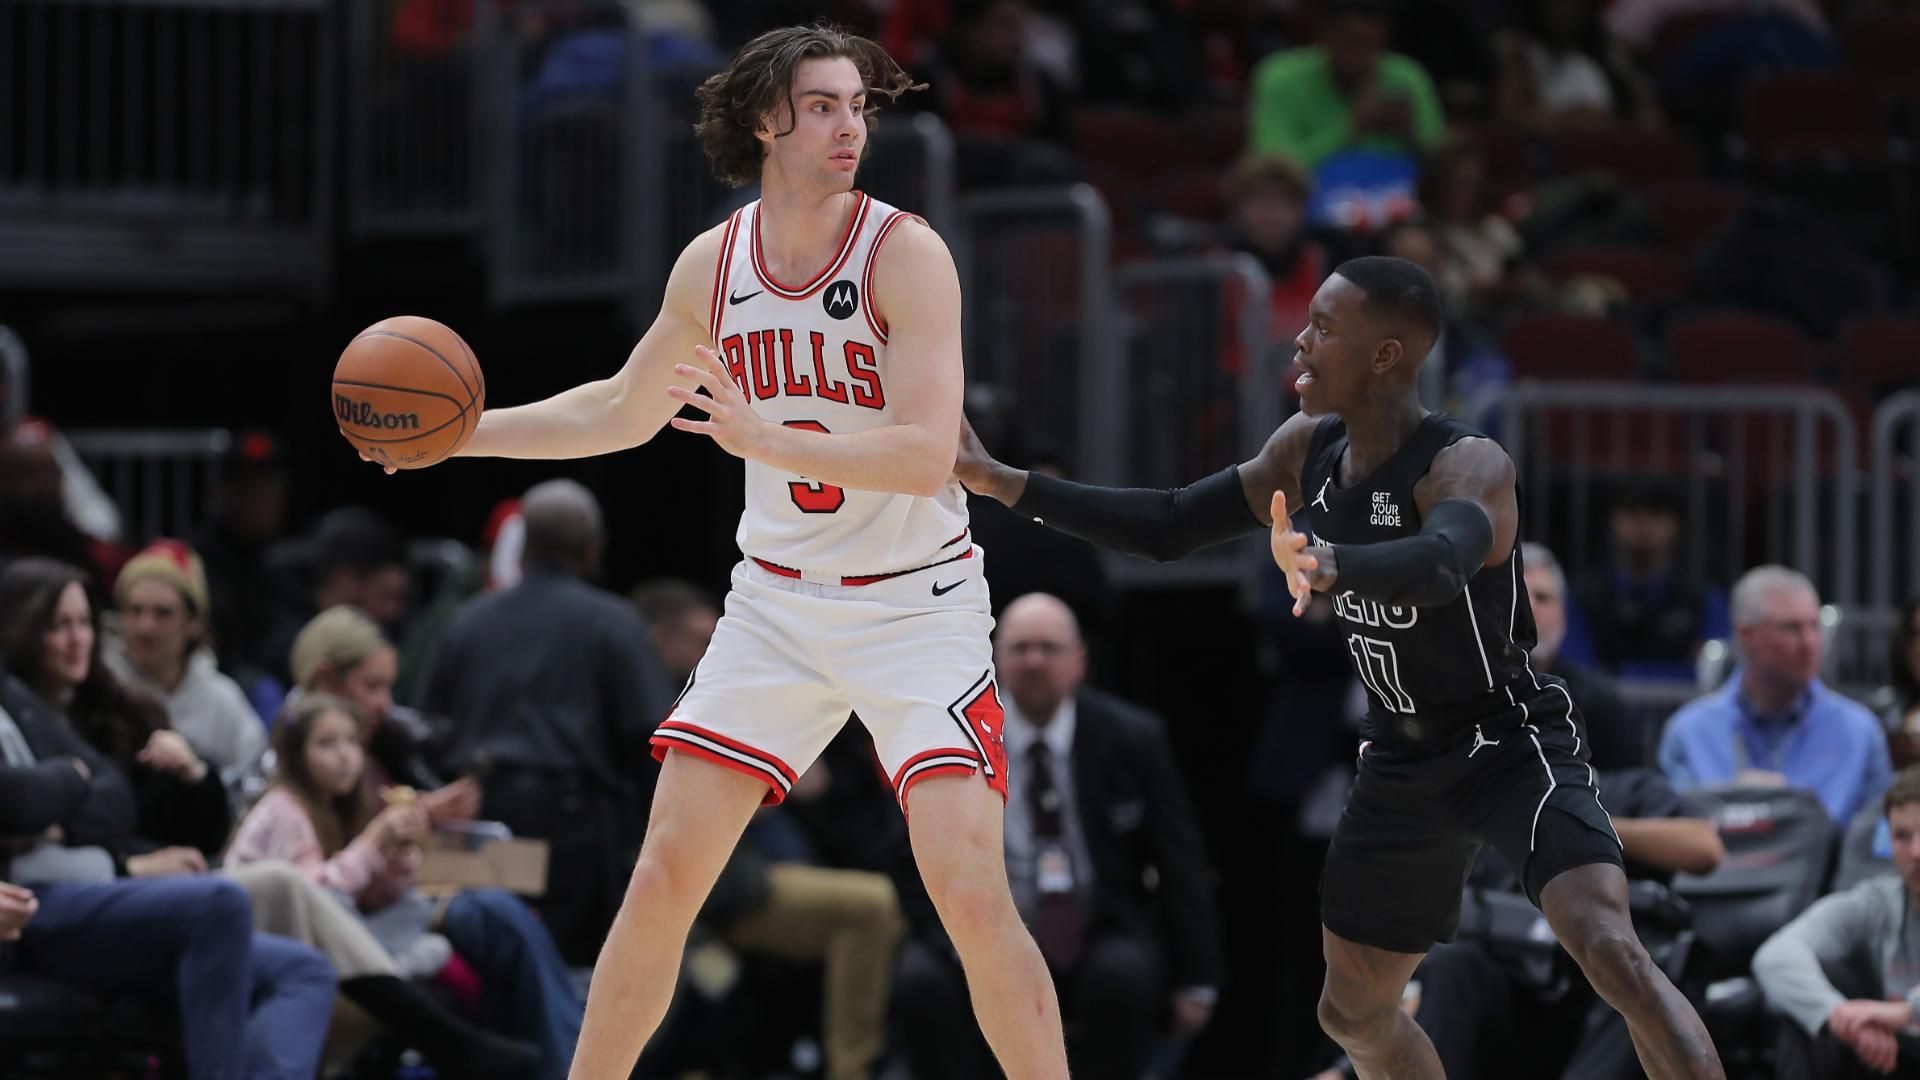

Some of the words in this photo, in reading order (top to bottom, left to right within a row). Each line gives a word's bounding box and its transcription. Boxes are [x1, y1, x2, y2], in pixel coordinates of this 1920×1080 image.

[722, 328, 886, 411] BULLS
[335, 393, 420, 429] Wilson
[1372, 491, 1391, 503] GET
[1372, 503, 1399, 515] YOUR
[1370, 514, 1402, 527] GUIDE
[1348, 633, 1416, 714] 17
